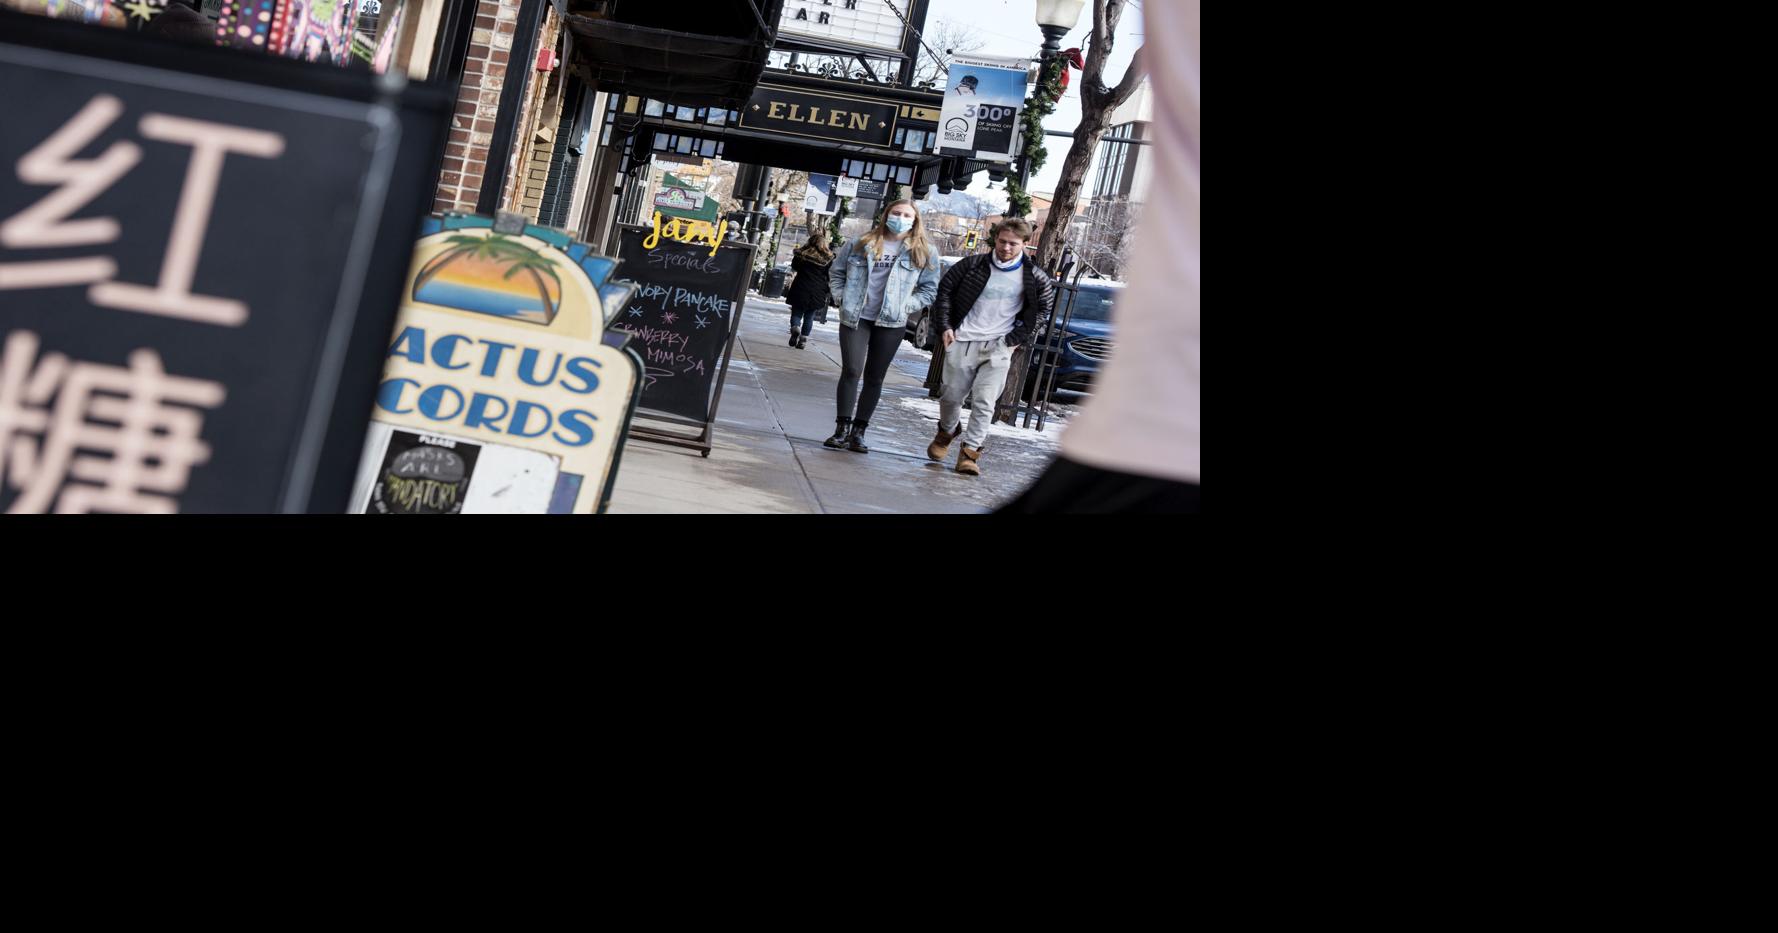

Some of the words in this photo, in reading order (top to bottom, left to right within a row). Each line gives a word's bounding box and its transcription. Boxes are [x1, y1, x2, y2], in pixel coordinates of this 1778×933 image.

[766, 101, 871, 132] ELLEN
[386, 326, 603, 394] ACTUS
[647, 346, 705, 376] MIMOSA
[375, 378, 598, 447] CORDS
